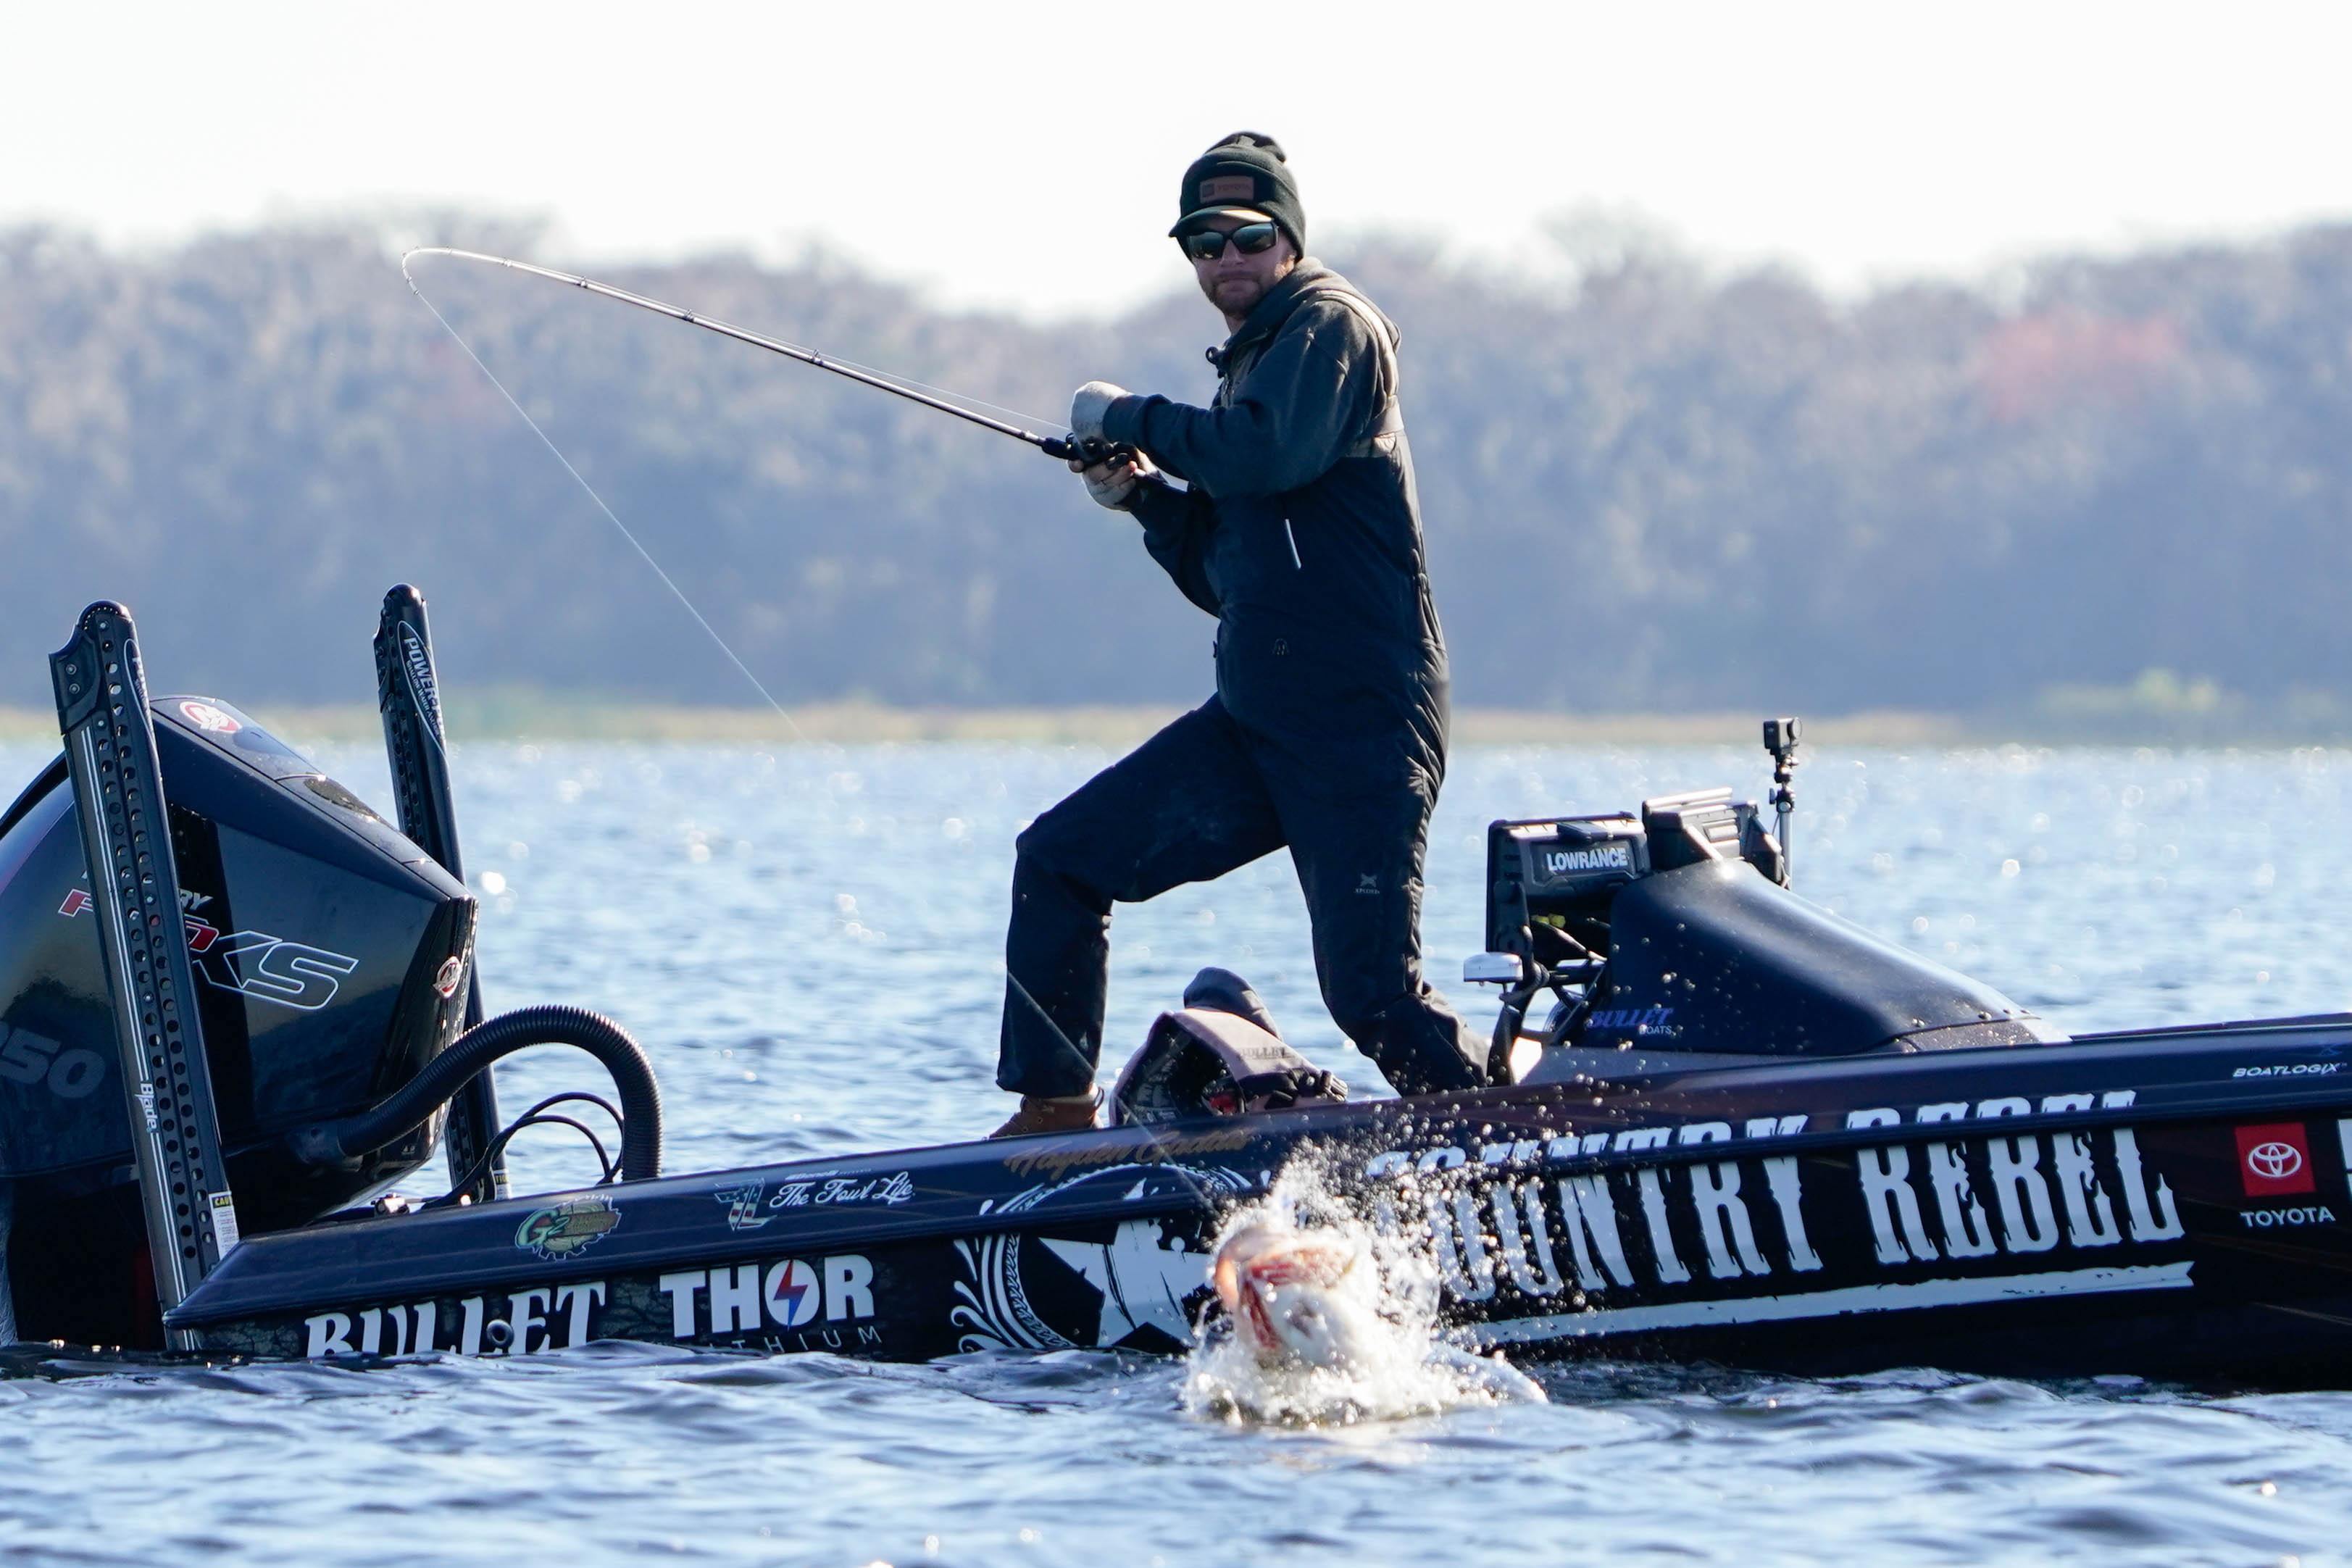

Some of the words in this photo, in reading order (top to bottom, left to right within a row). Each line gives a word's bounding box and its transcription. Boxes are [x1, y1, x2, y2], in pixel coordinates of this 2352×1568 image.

[1546, 847, 1628, 871] LOWRANCE
[1586, 1007, 1673, 1028] BULLET
[0, 1020, 106, 1099] 50
[2232, 1062, 2340, 1078] BOATLOGIX
[133, 1083, 158, 1130] Blade
[769, 1180, 816, 1209] The
[814, 1178, 877, 1204] Fowl
[872, 1170, 914, 1205] Life
[1845, 1089, 2186, 1265] REBEL
[2240, 1205, 2337, 1228] TOYOTA
[659, 1254, 875, 1339] THOR
